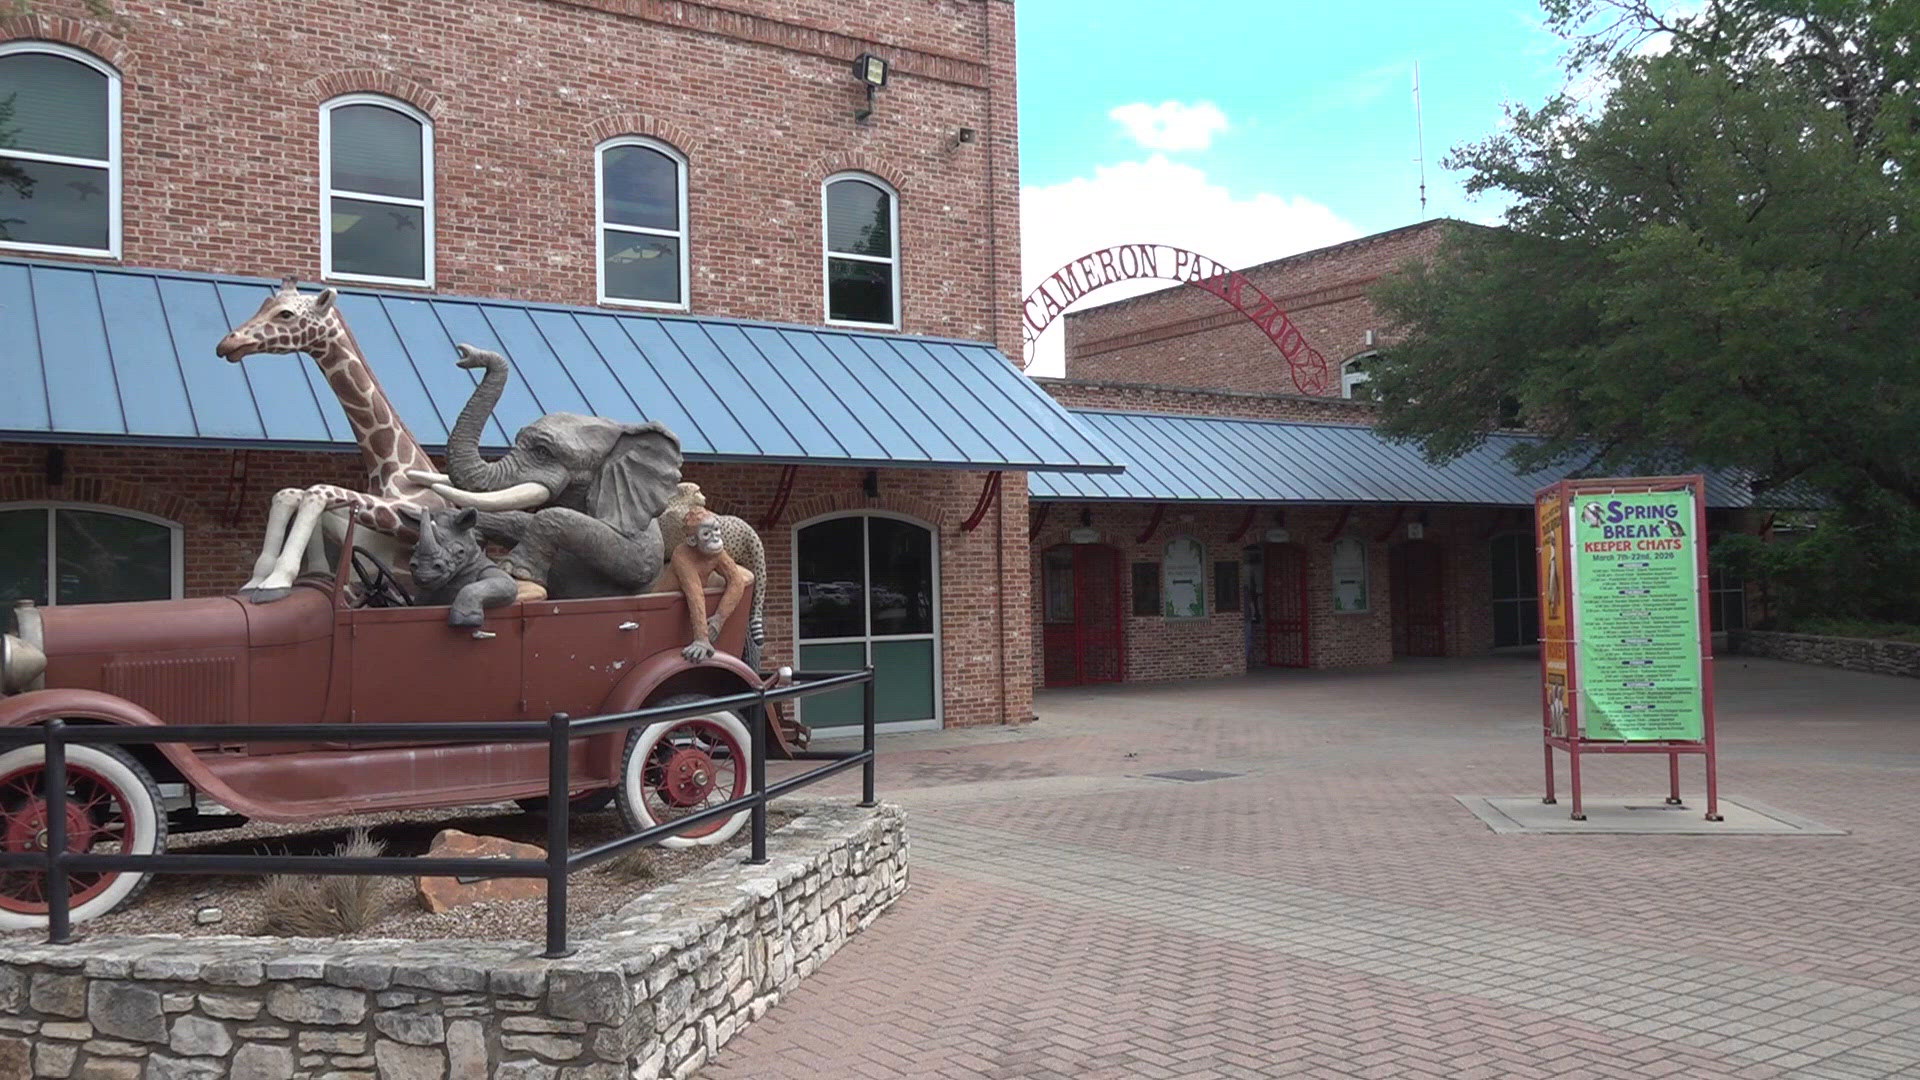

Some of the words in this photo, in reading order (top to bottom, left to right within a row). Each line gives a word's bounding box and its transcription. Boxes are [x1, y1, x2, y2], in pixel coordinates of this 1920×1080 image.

[1023, 245, 1157, 333] CAMERON
[1172, 248, 1250, 310] PARK
[1249, 299, 1301, 357] ZOO
[1607, 501, 1678, 523] SPRING
[1604, 525, 1661, 539] BREAK
[1585, 542, 1631, 552] KEEPER
[1638, 540, 1682, 550] CHATS
